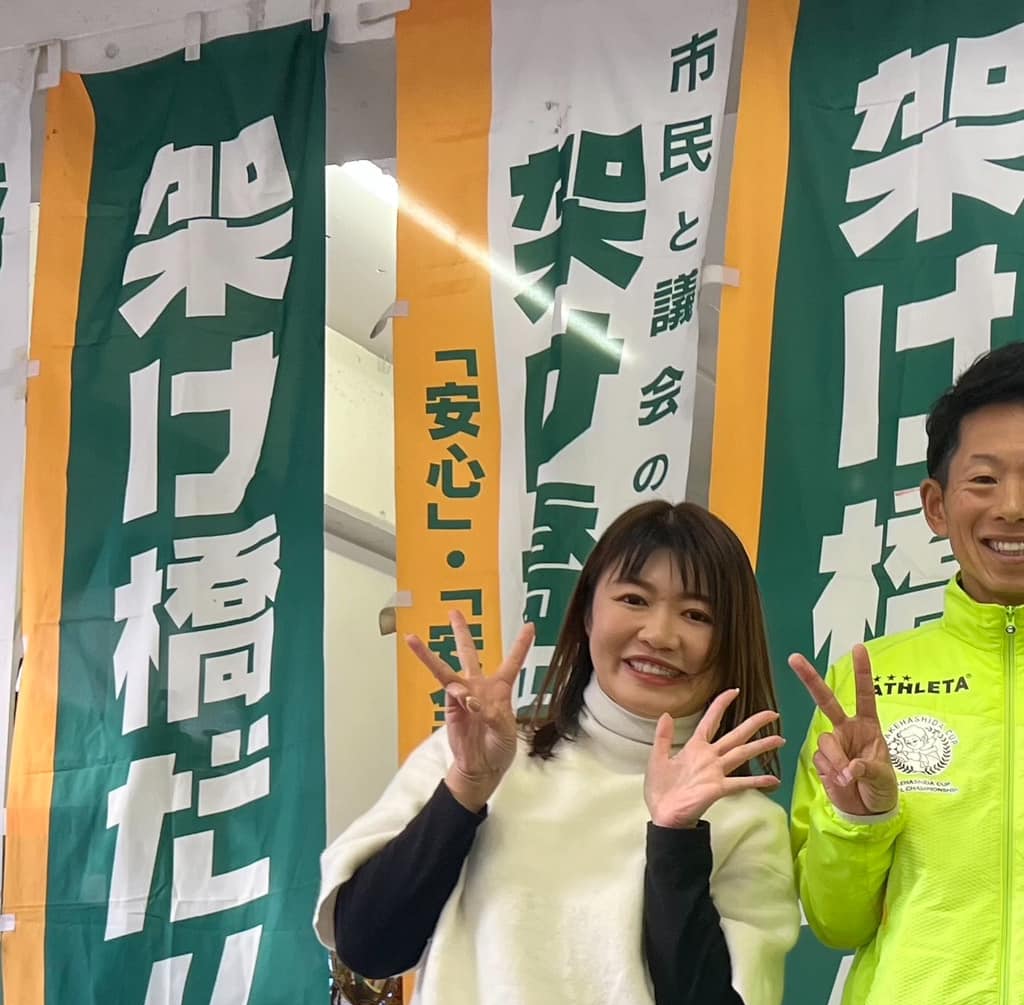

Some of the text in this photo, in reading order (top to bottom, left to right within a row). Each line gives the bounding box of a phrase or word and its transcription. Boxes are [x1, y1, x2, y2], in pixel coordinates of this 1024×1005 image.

[633, 27, 718, 491] 市民と議会の
